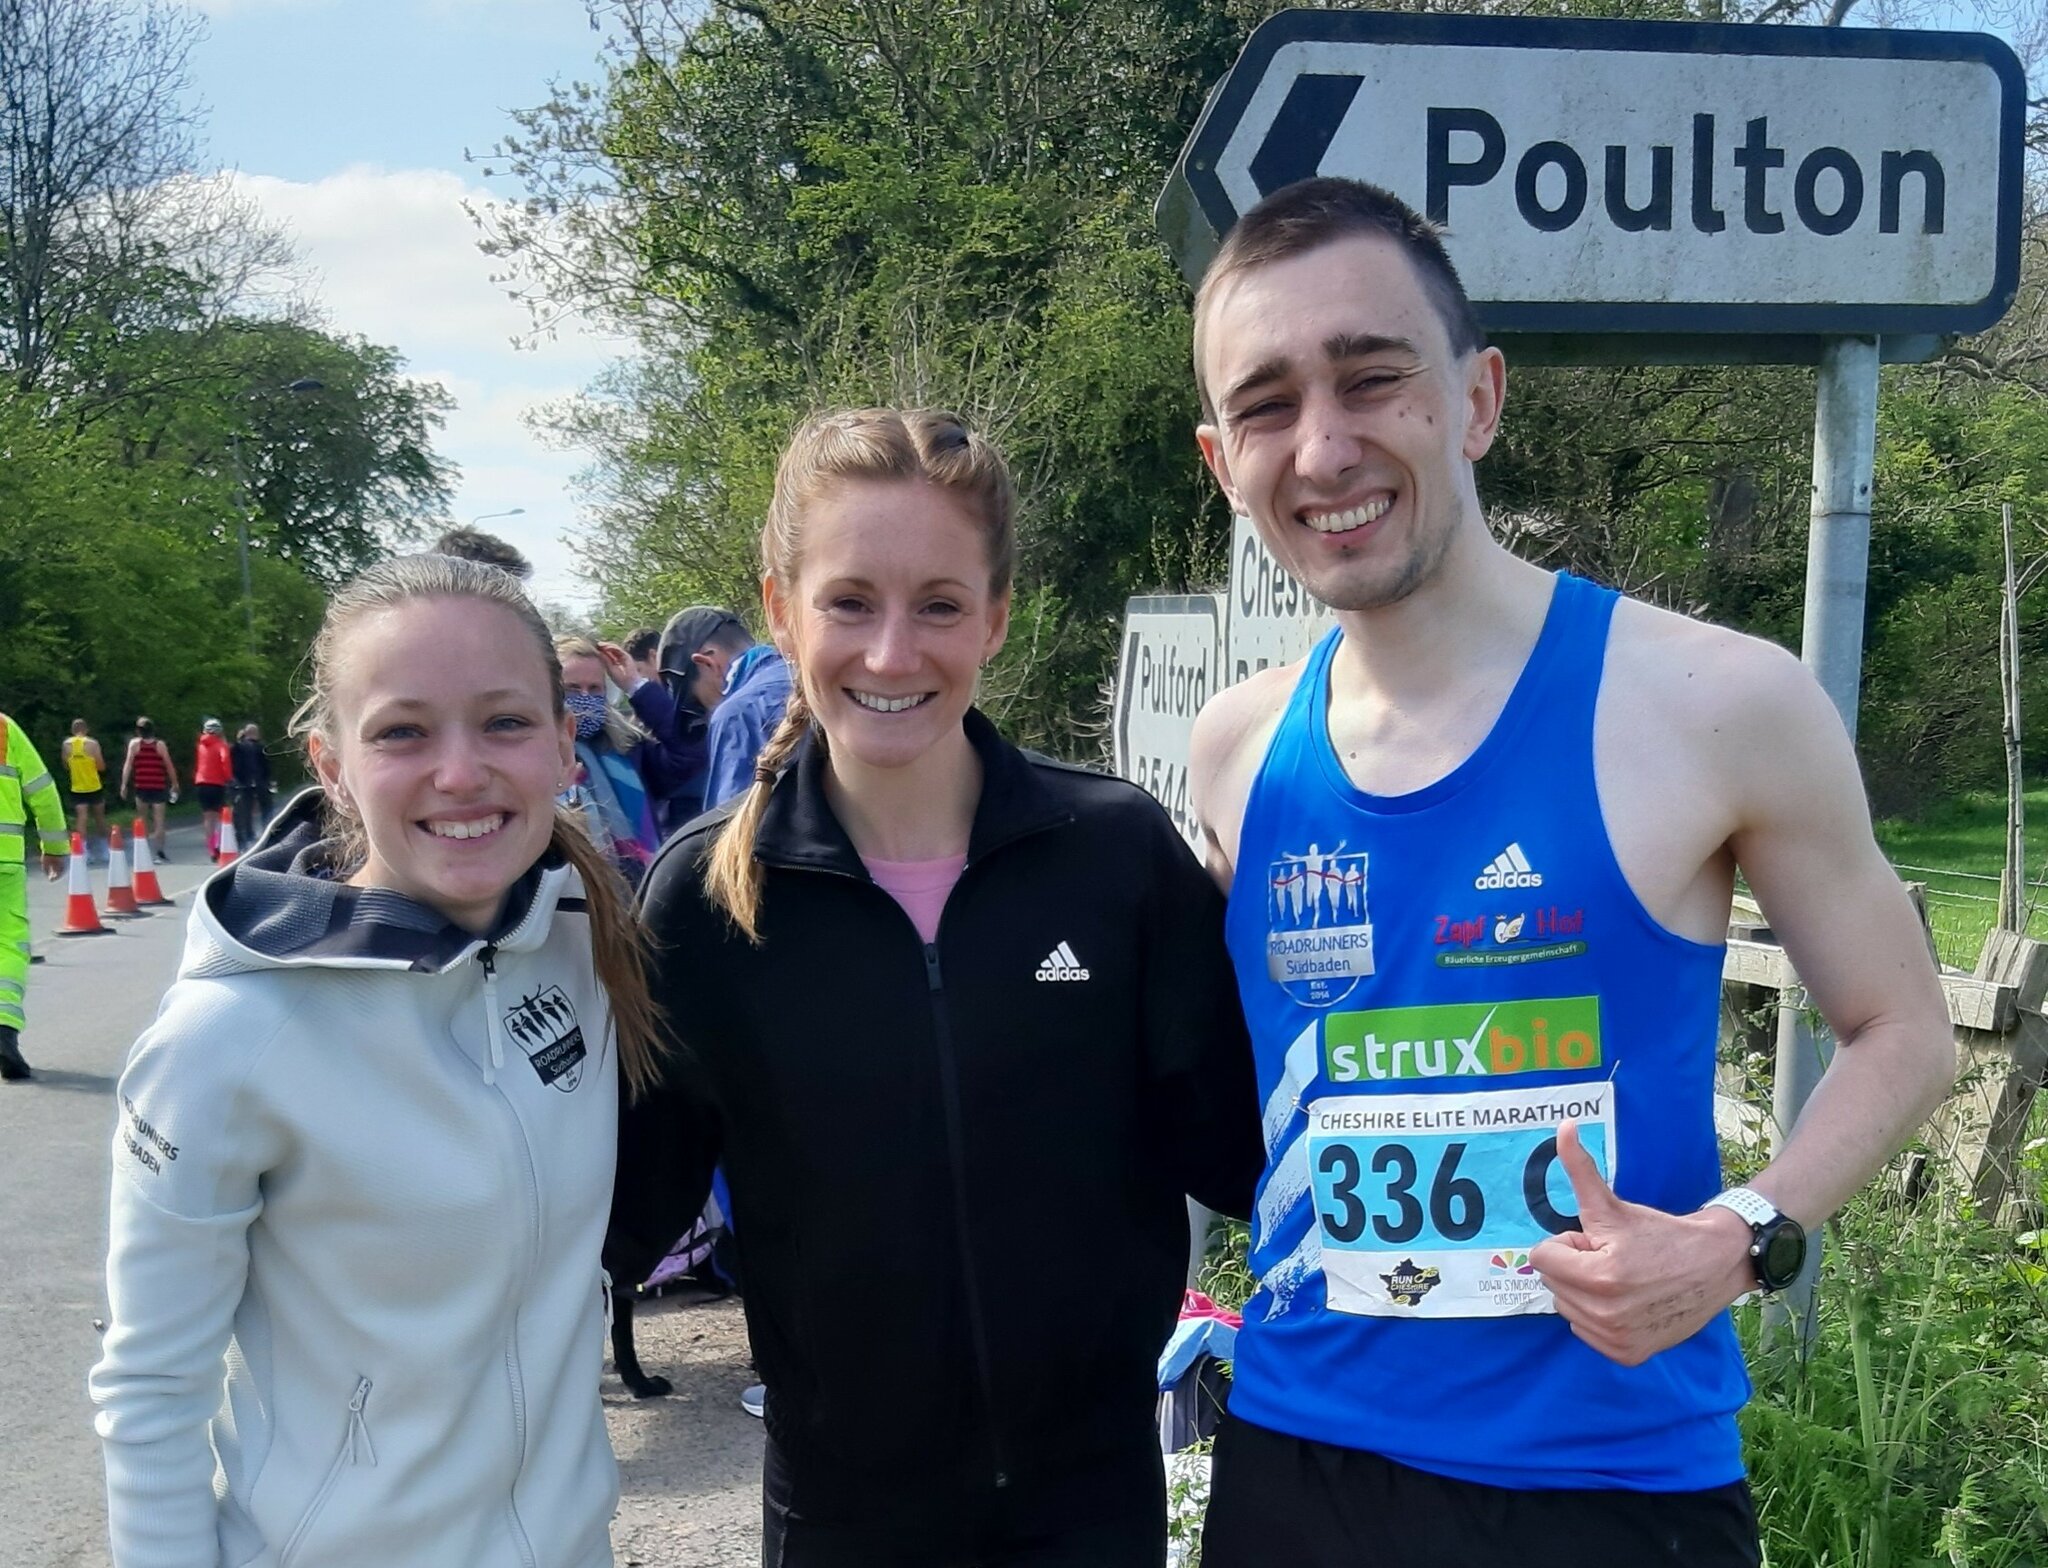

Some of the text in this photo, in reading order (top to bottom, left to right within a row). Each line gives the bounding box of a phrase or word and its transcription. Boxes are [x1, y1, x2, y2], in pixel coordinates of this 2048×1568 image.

[1426, 106, 1946, 235] Poulton
[1240, 535, 1335, 618] Ches
[1140, 643, 1208, 718] Pulford
[1475, 870, 1543, 890] adidas
[1270, 933, 1369, 956] ROADRUNNERS
[1434, 901, 1585, 949] Zapf Hof
[1035, 966, 1091, 982] adidas
[1320, 1098, 1602, 1131] CHESHIRE ELITE MARATHON
[1318, 1142, 1486, 1244] 336
[1391, 1275, 1413, 1285] RUN
